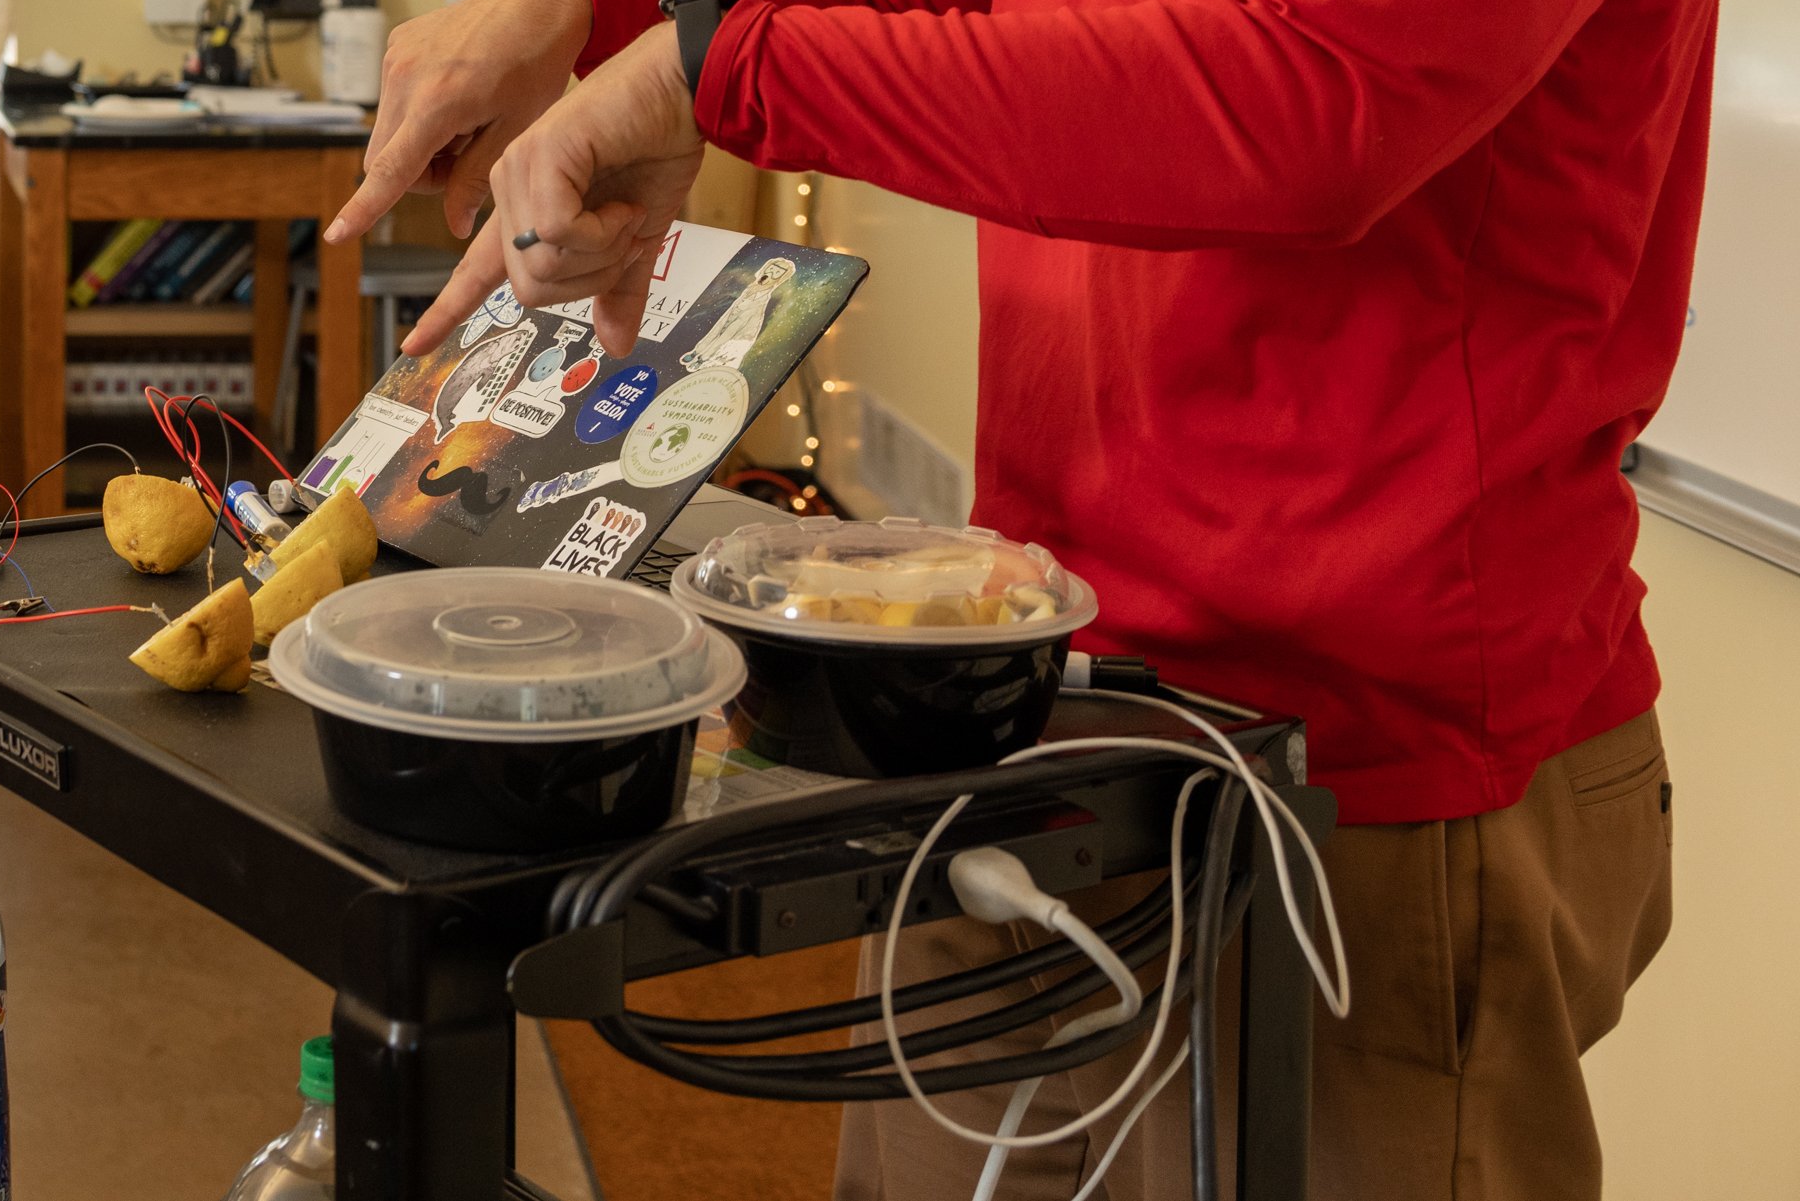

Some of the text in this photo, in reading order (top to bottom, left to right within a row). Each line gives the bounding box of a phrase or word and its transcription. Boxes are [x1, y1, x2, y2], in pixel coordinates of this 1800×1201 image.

[593, 399, 628, 422] VOTED
[661, 398, 735, 416] SUSTAINABILITY
[662, 410, 714, 425] SYMPOSIUM
[568, 522, 627, 560] BLACK
[548, 544, 610, 577] LIVES
[0, 727, 57, 779] LUXOR
